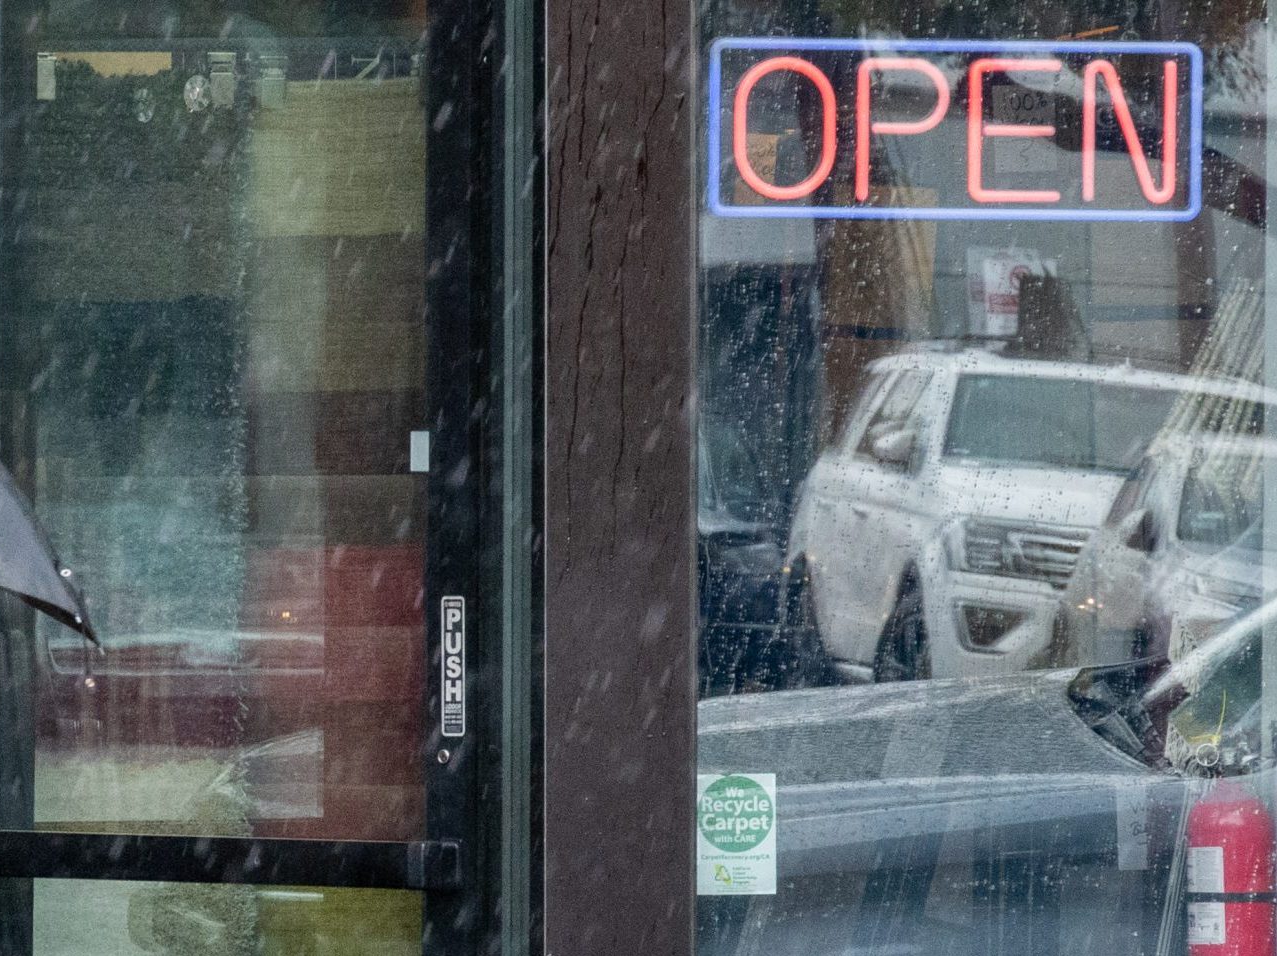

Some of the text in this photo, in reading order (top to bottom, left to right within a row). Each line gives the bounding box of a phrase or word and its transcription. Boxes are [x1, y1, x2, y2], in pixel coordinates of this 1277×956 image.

[733, 56, 1178, 204] OPEN
[445, 609, 462, 702] PUSH
[725, 787, 744, 797] We
[701, 795, 770, 816] Recycle
[702, 813, 769, 835] Carpet
[714, 835, 756, 843] with CARE
